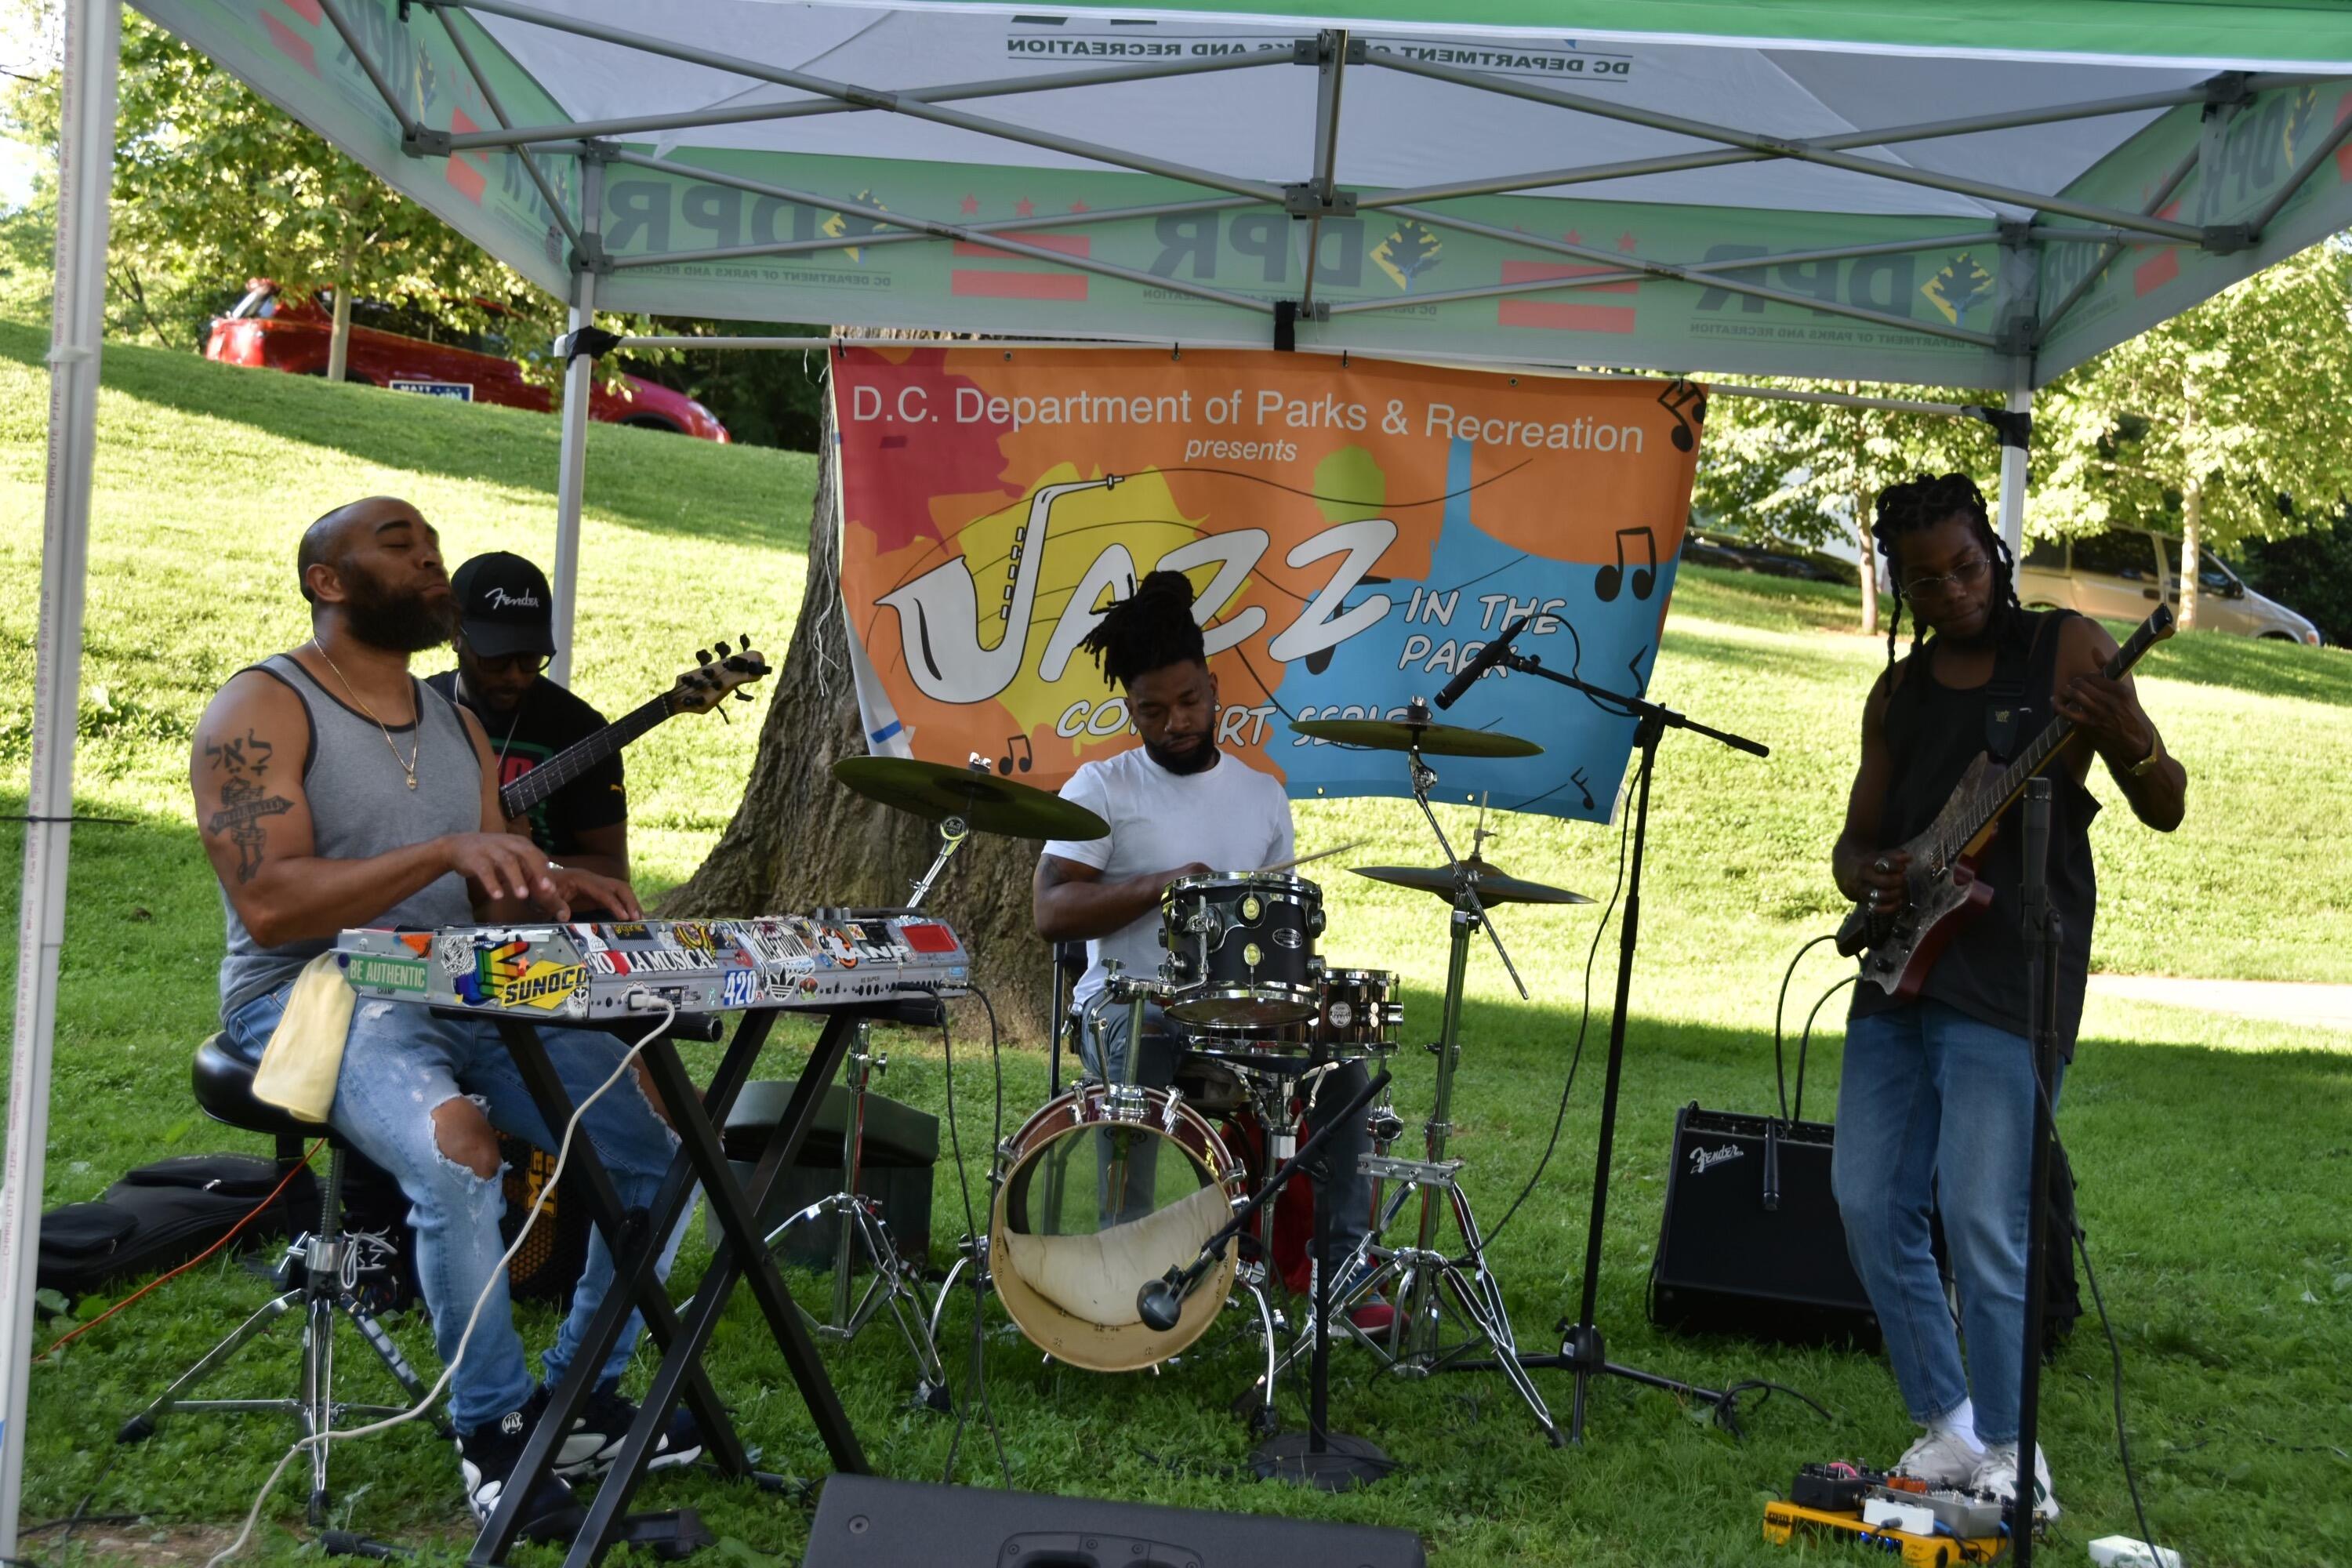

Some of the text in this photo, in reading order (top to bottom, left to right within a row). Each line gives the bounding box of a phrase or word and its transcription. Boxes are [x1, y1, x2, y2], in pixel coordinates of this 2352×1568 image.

[854, 386, 1643, 453] D.C. Department of Parks & Recreation
[1185, 437, 1298, 462] presents
[485, 587, 539, 610] Fender
[1404, 586, 1566, 635] IN THE
[350, 960, 426, 988] BE AUTHENTIC
[724, 971, 757, 1006] 420
[1690, 1144, 1744, 1174] Fender
